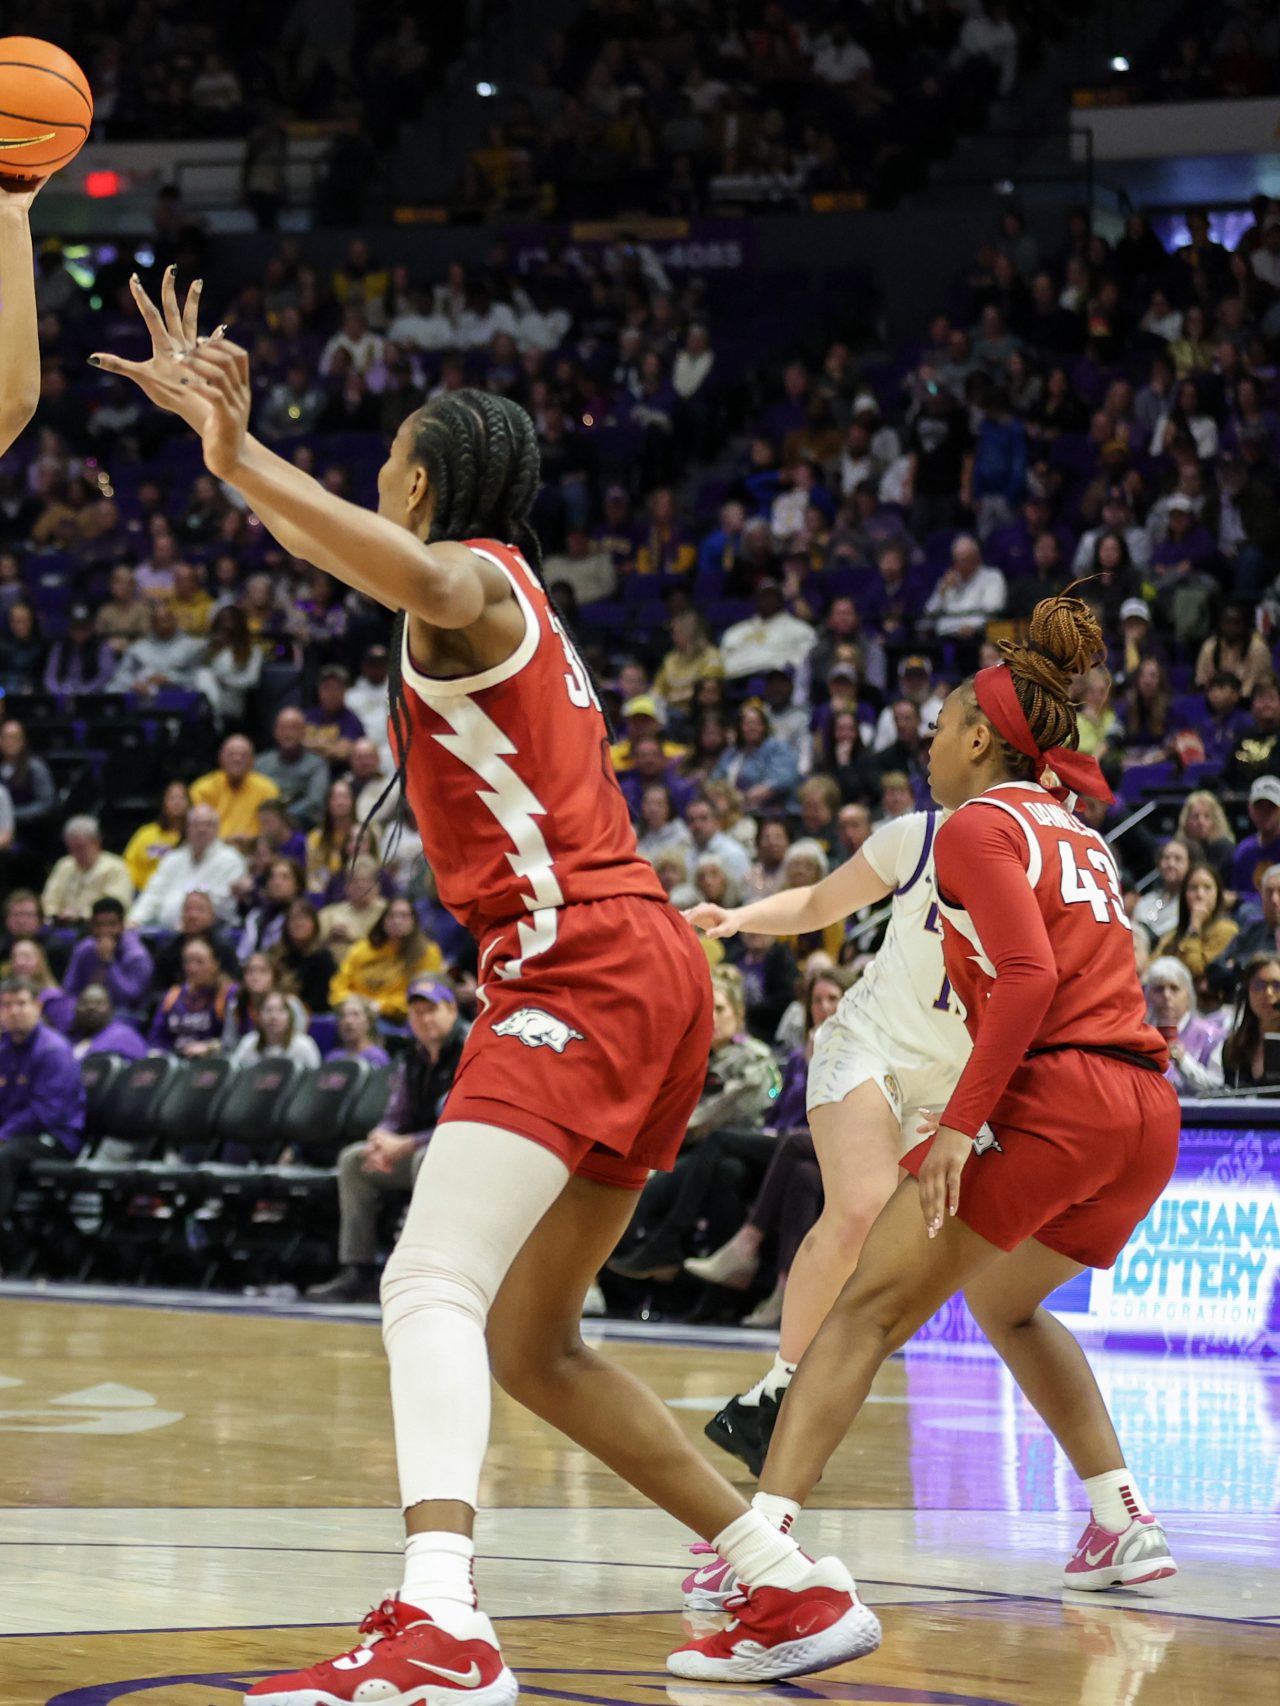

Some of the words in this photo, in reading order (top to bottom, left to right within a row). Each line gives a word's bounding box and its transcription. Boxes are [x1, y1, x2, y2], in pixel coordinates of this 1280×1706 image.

[1058, 840, 1132, 931] 43
[1112, 1249, 1267, 1301] LOTTERY
[1110, 1298, 1256, 1323] CORPORATION
